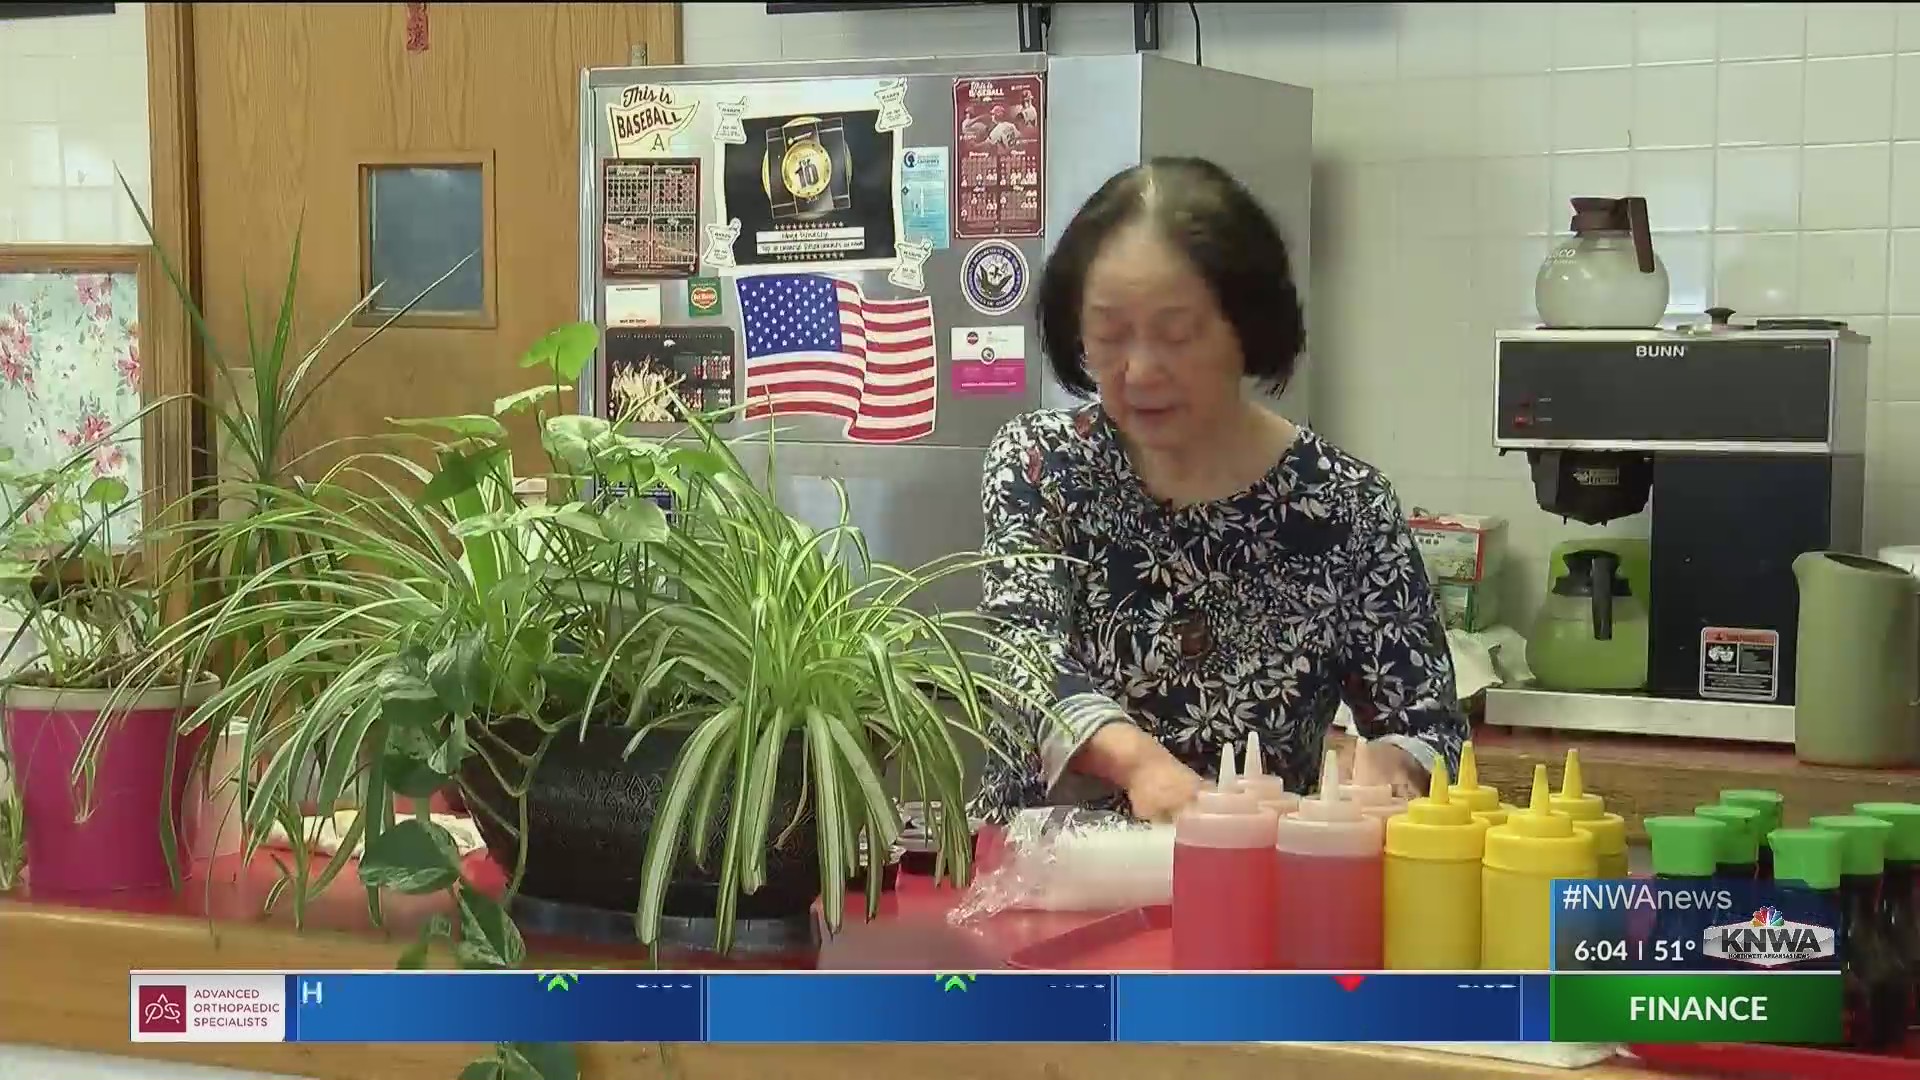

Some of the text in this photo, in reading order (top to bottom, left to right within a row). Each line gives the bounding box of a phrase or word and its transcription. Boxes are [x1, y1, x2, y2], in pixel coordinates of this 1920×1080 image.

[622, 85, 672, 108] This is
[616, 106, 682, 139] BASEBALL
[649, 133, 665, 152] A
[795, 163, 820, 189] 10
[1636, 345, 1685, 358] BUNN
